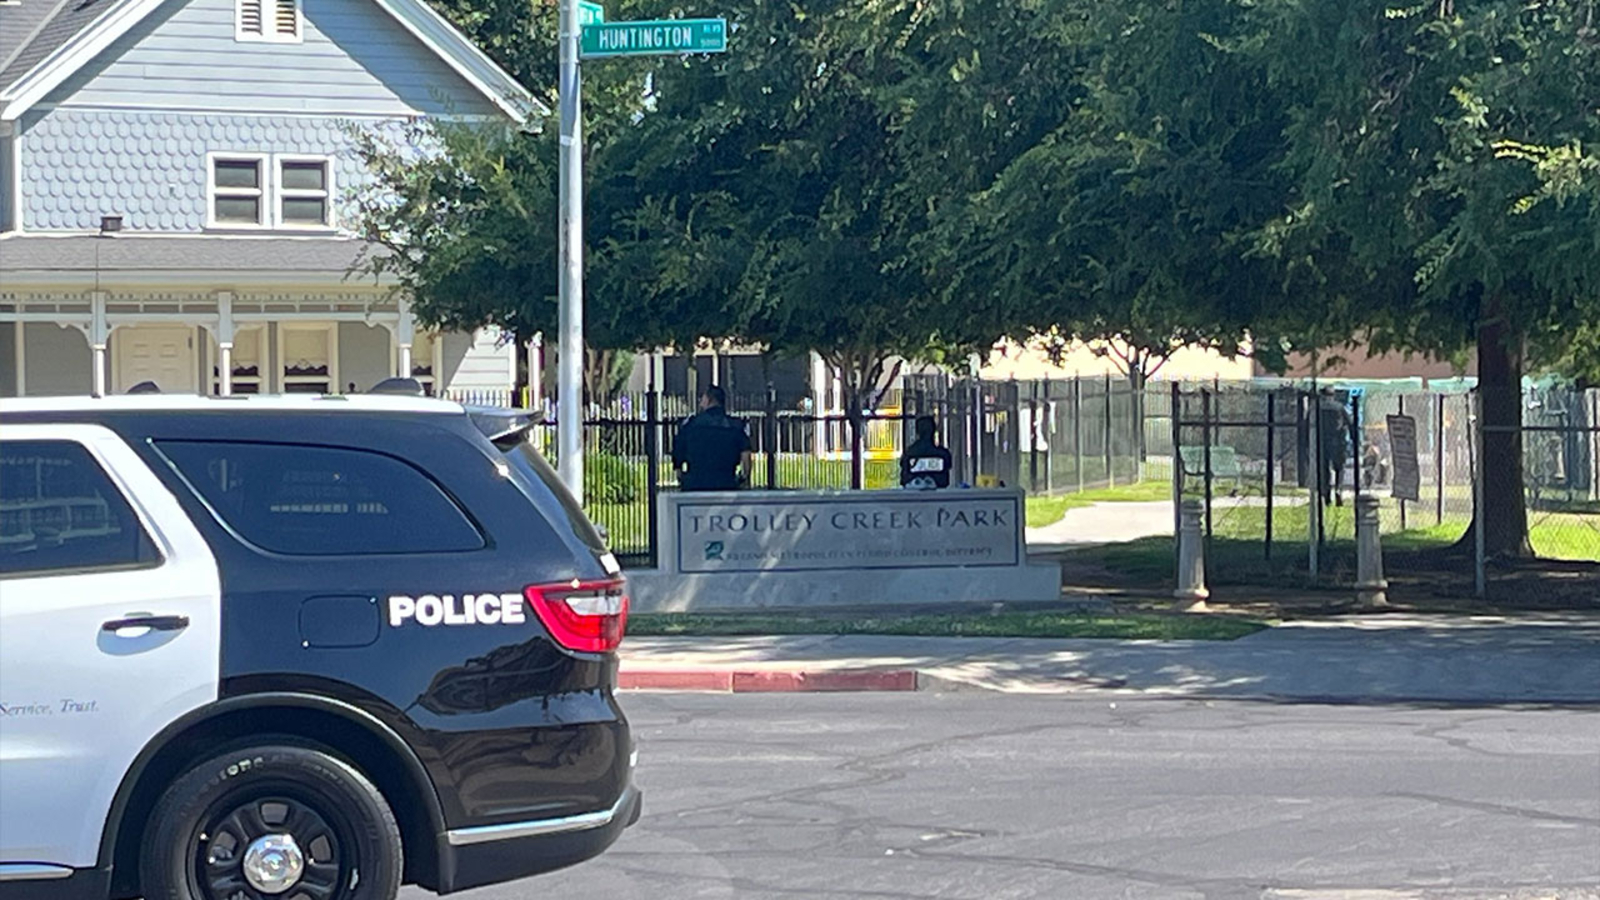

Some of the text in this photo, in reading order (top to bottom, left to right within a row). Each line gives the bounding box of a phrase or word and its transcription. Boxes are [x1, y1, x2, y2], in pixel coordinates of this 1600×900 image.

[600, 27, 692, 49] HUNTINGTON
[690, 507, 1009, 533] TROLLEY CREEK PARK
[388, 593, 526, 626] POLICE
